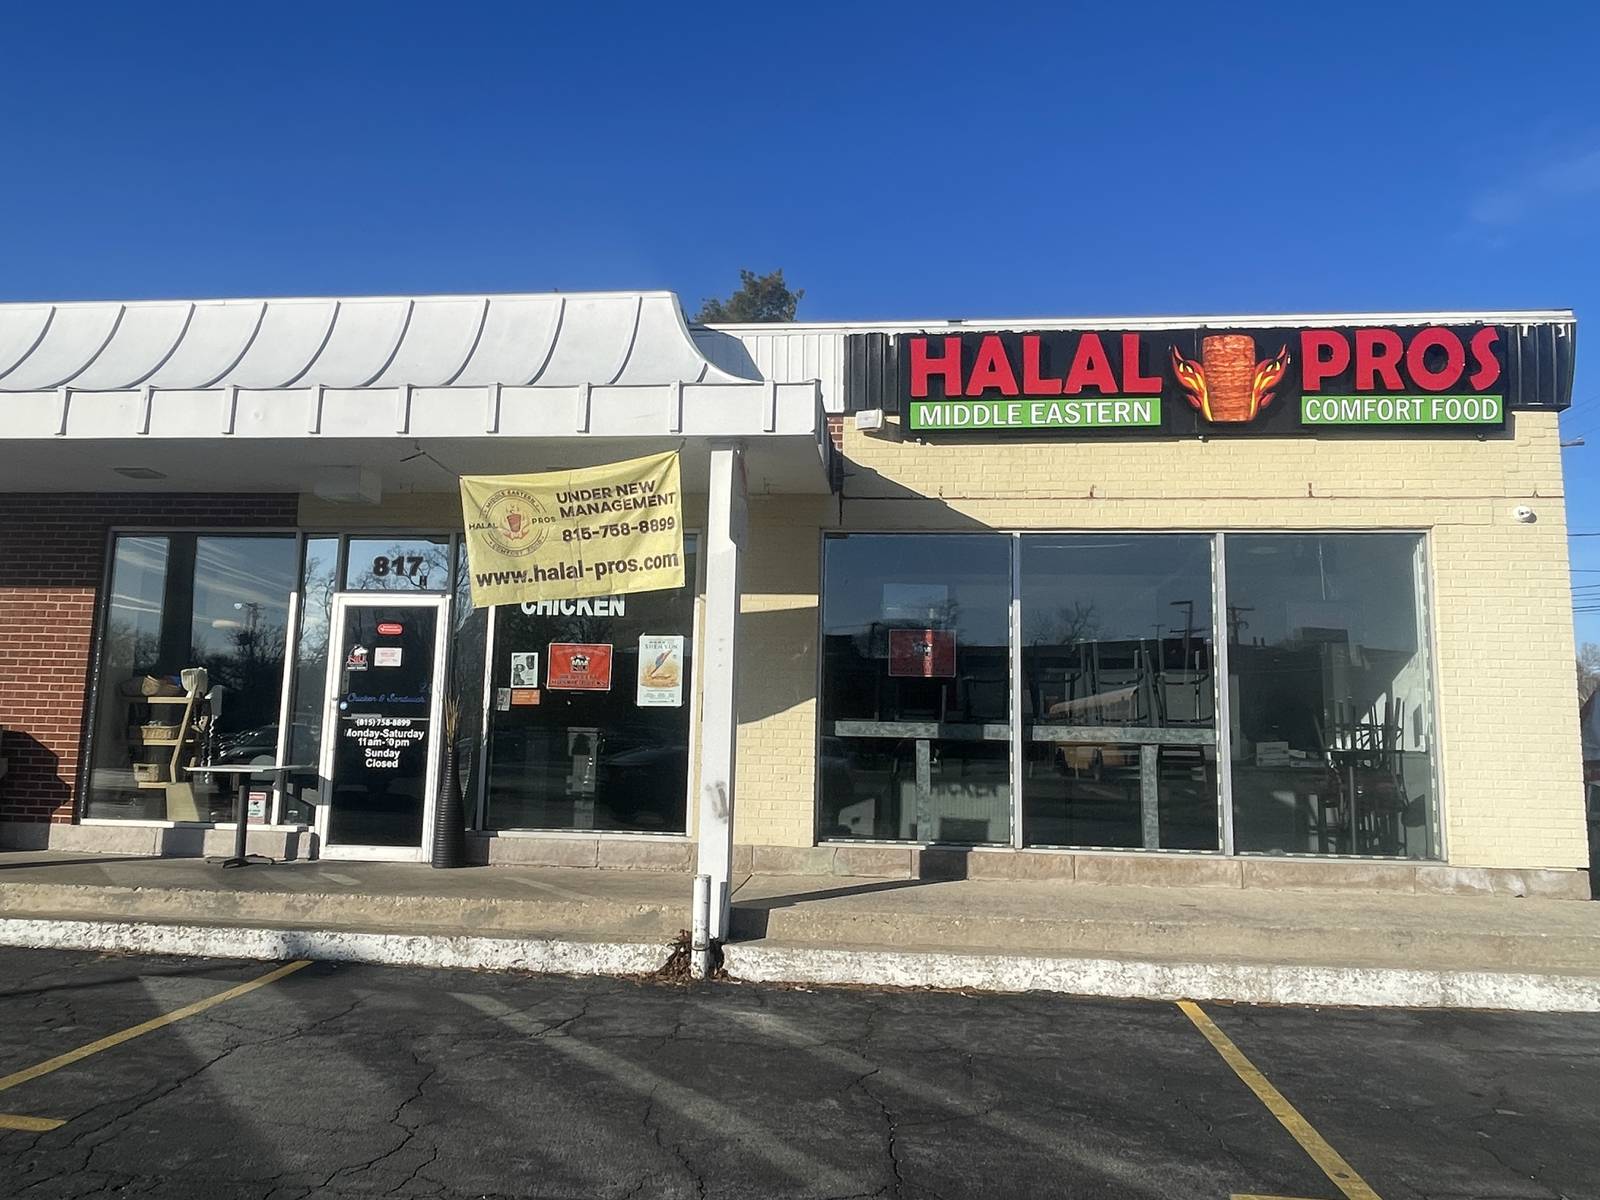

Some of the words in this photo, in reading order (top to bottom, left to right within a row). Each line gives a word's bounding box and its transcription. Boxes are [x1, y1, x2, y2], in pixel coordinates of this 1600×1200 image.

[910, 334, 1163, 397] HALAL
[1301, 327, 1500, 391] PROS
[918, 404, 1022, 427] MIDDLE
[1030, 401, 1151, 425] EASTERN
[1305, 399, 1425, 421] COMFORT
[1431, 398, 1499, 421] FOOD
[556, 486, 612, 505] UNDER
[615, 479, 656, 497] NEW
[559, 492, 676, 519] MANAGEMENT
[468, 522, 498, 531] HALAL
[531, 515, 556, 525] PROS
[562, 516, 676, 542] 815-758-8899
[373, 555, 424, 577] 817
[476, 552, 679, 588] www.halal-pros.com
[520, 594, 626, 617] CHICKEN
[364, 748, 401, 760] Sunday
[365, 759, 399, 768] Closed
